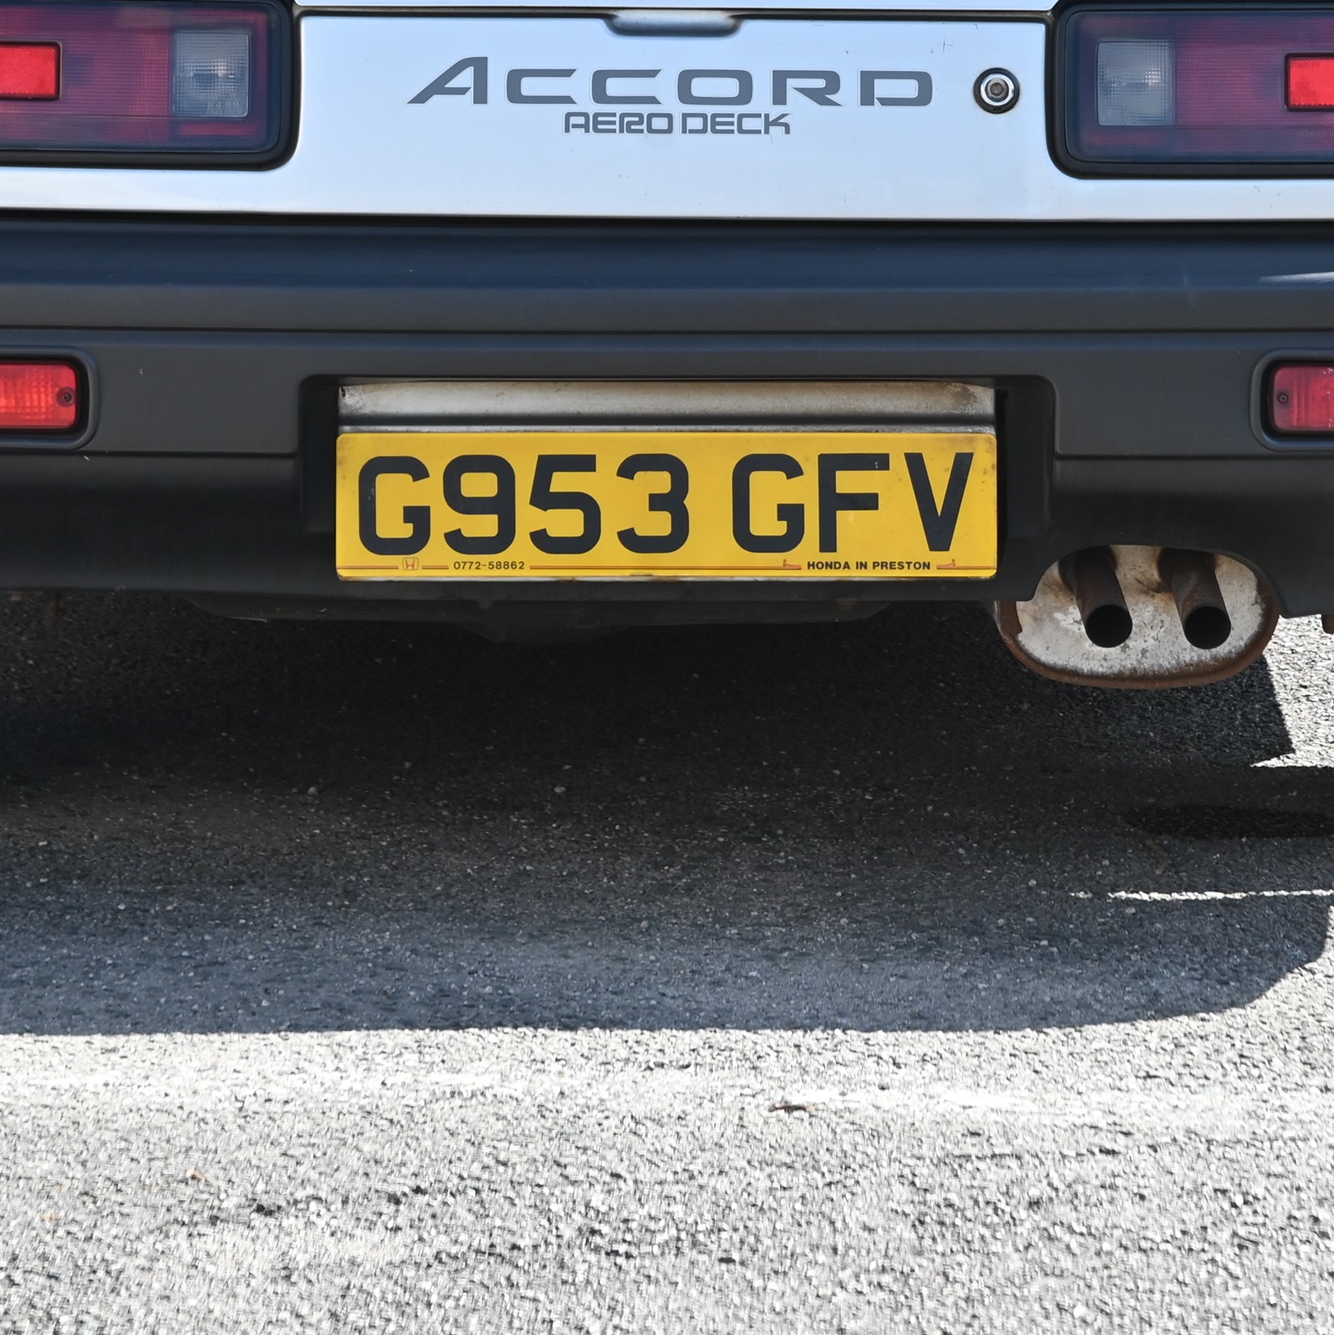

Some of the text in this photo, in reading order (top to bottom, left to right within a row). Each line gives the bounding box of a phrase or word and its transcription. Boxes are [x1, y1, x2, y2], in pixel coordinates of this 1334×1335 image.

[407, 56, 933, 107] ACCORD
[358, 452, 975, 555] G953 GFV
[453, 561, 525, 570] 0772-58862
[807, 561, 931, 570] HONDA IN PRESTON
